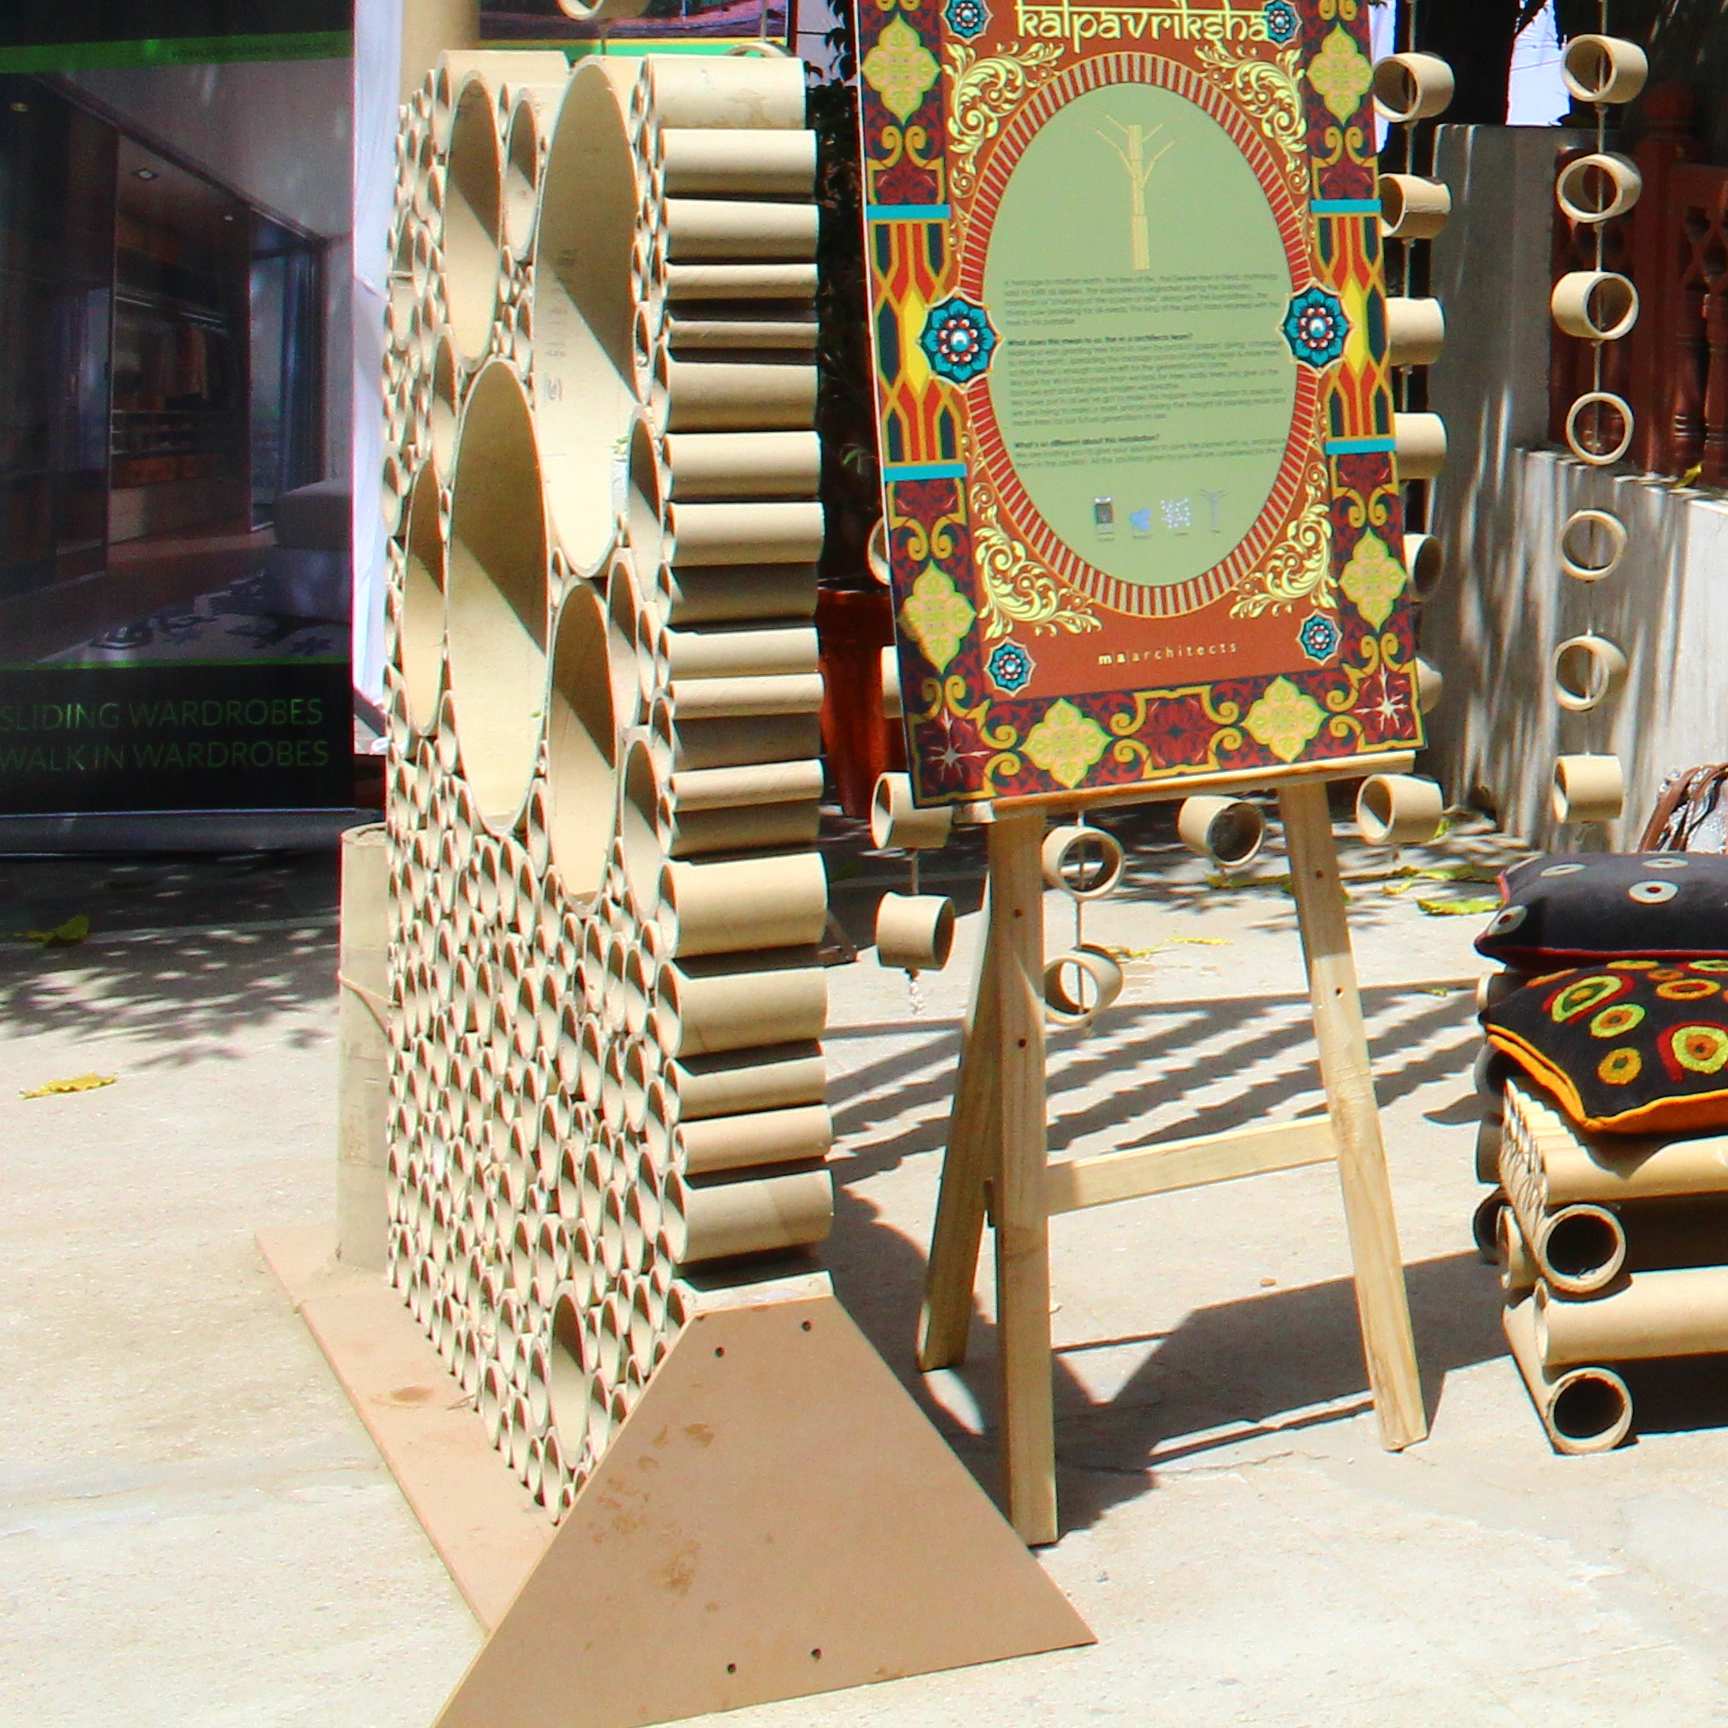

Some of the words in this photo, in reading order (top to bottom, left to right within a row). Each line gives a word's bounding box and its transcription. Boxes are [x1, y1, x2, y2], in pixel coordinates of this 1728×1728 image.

[129, 698, 323, 728] WARDROBES
[95, 743, 124, 770] IN
[133, 740, 329, 769] WARDROBES
